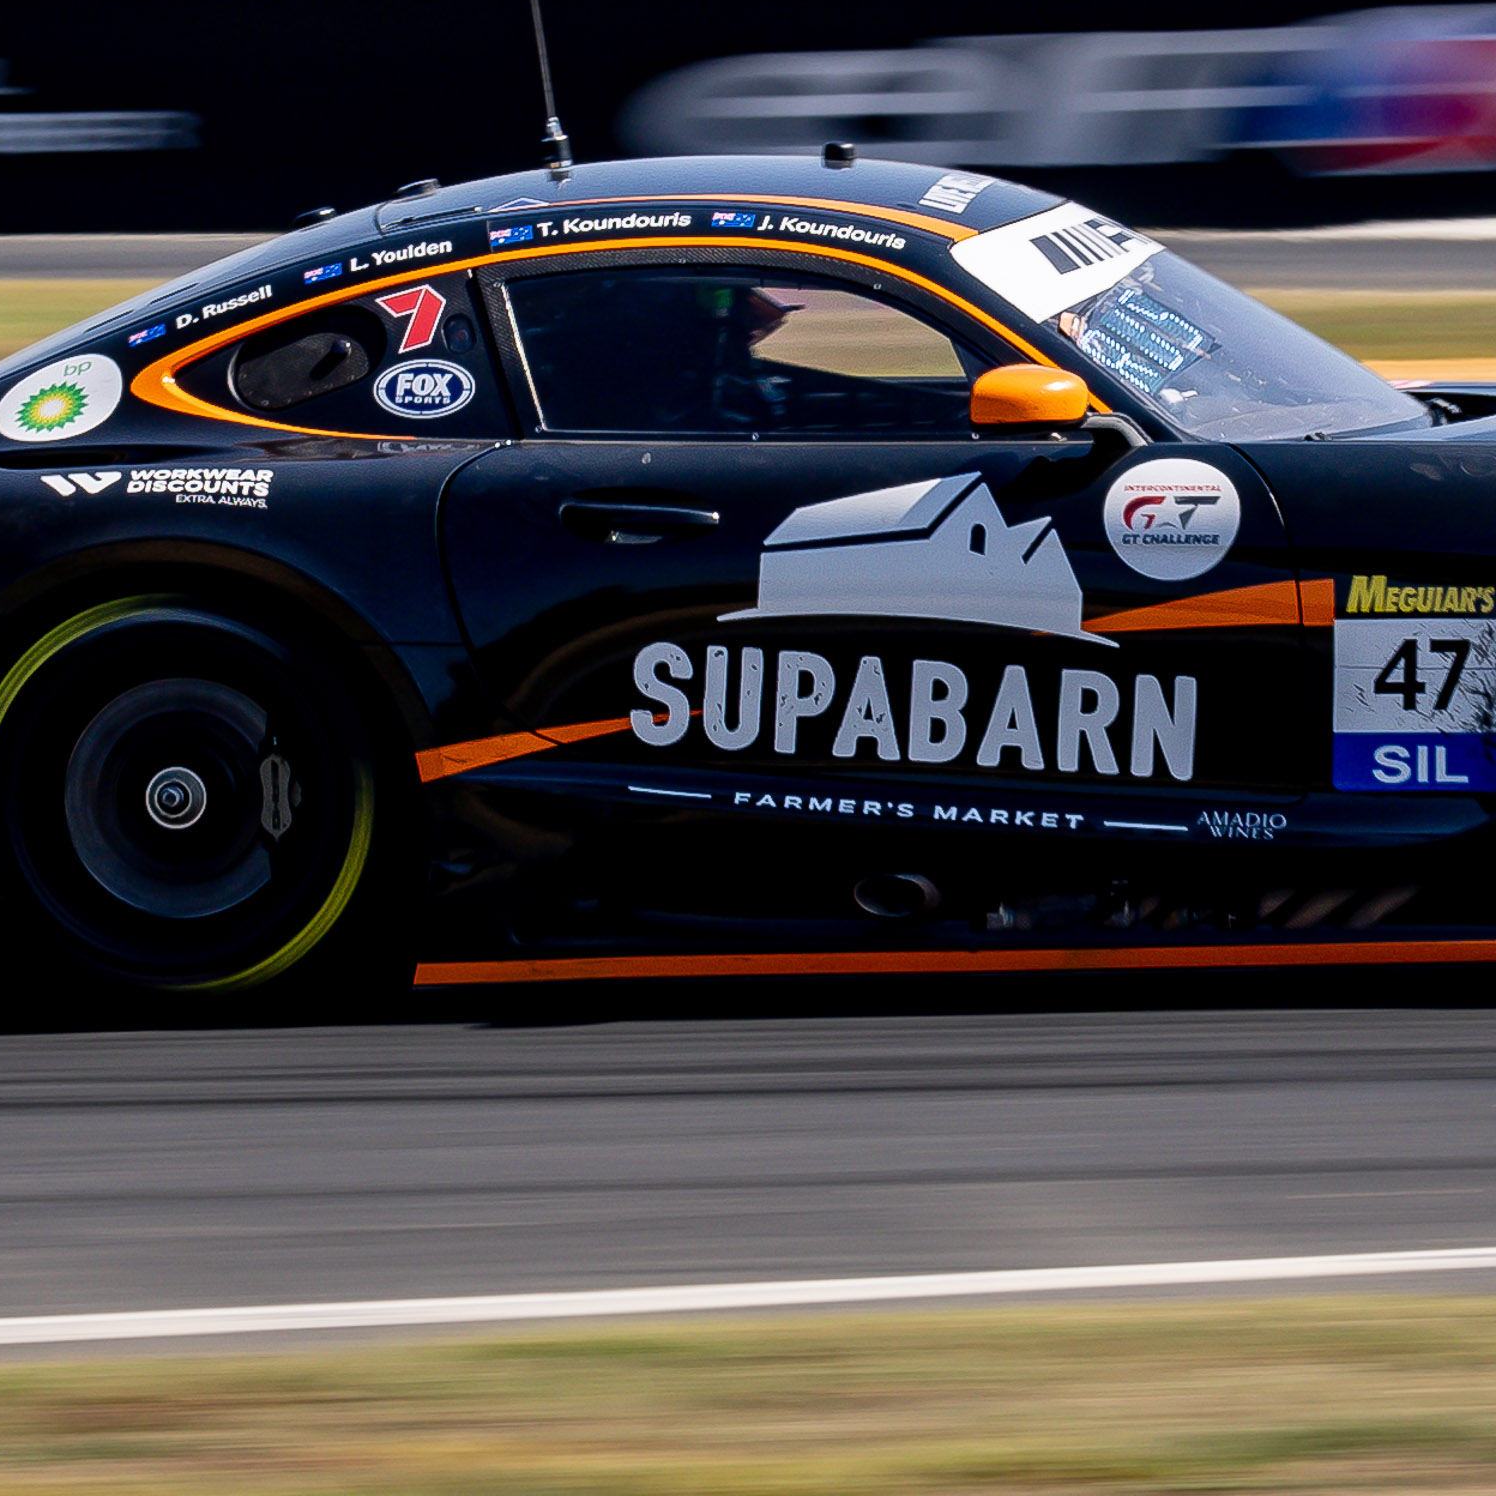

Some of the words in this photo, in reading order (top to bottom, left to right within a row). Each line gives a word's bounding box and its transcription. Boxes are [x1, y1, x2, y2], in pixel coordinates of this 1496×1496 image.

[536, 221, 559, 237] T.
[563, 212, 692, 234] Koundouris
[757, 215, 774, 231] J.
[779, 216, 907, 250] Koundouris
[350, 257, 370, 272] L.
[371, 240, 453, 266] Youlden
[176, 313, 199, 329] D.
[202, 284, 273, 319] Russell
[63, 361, 92, 377] bp
[395, 373, 454, 397] FOX
[395, 396, 451, 404] SPORTS
[126, 479, 270, 497] DISCOUNTS
[131, 468, 274, 483] WORKWEAR
[1122, 534, 1141, 545] GT
[1142, 534, 1220, 545] CHALLENGE
[1346, 574, 1496, 614] MEGUIAR'S
[1373, 638, 1471, 712] 47
[629, 641, 1197, 781] SUPABARN
[1372, 745, 1469, 784] SIL
[734, 791, 915, 819] FARMER'S
[933, 805, 1085, 830] MARKET
[1196, 810, 1287, 829] AMADIO
[1210, 825, 1274, 840] WINES
